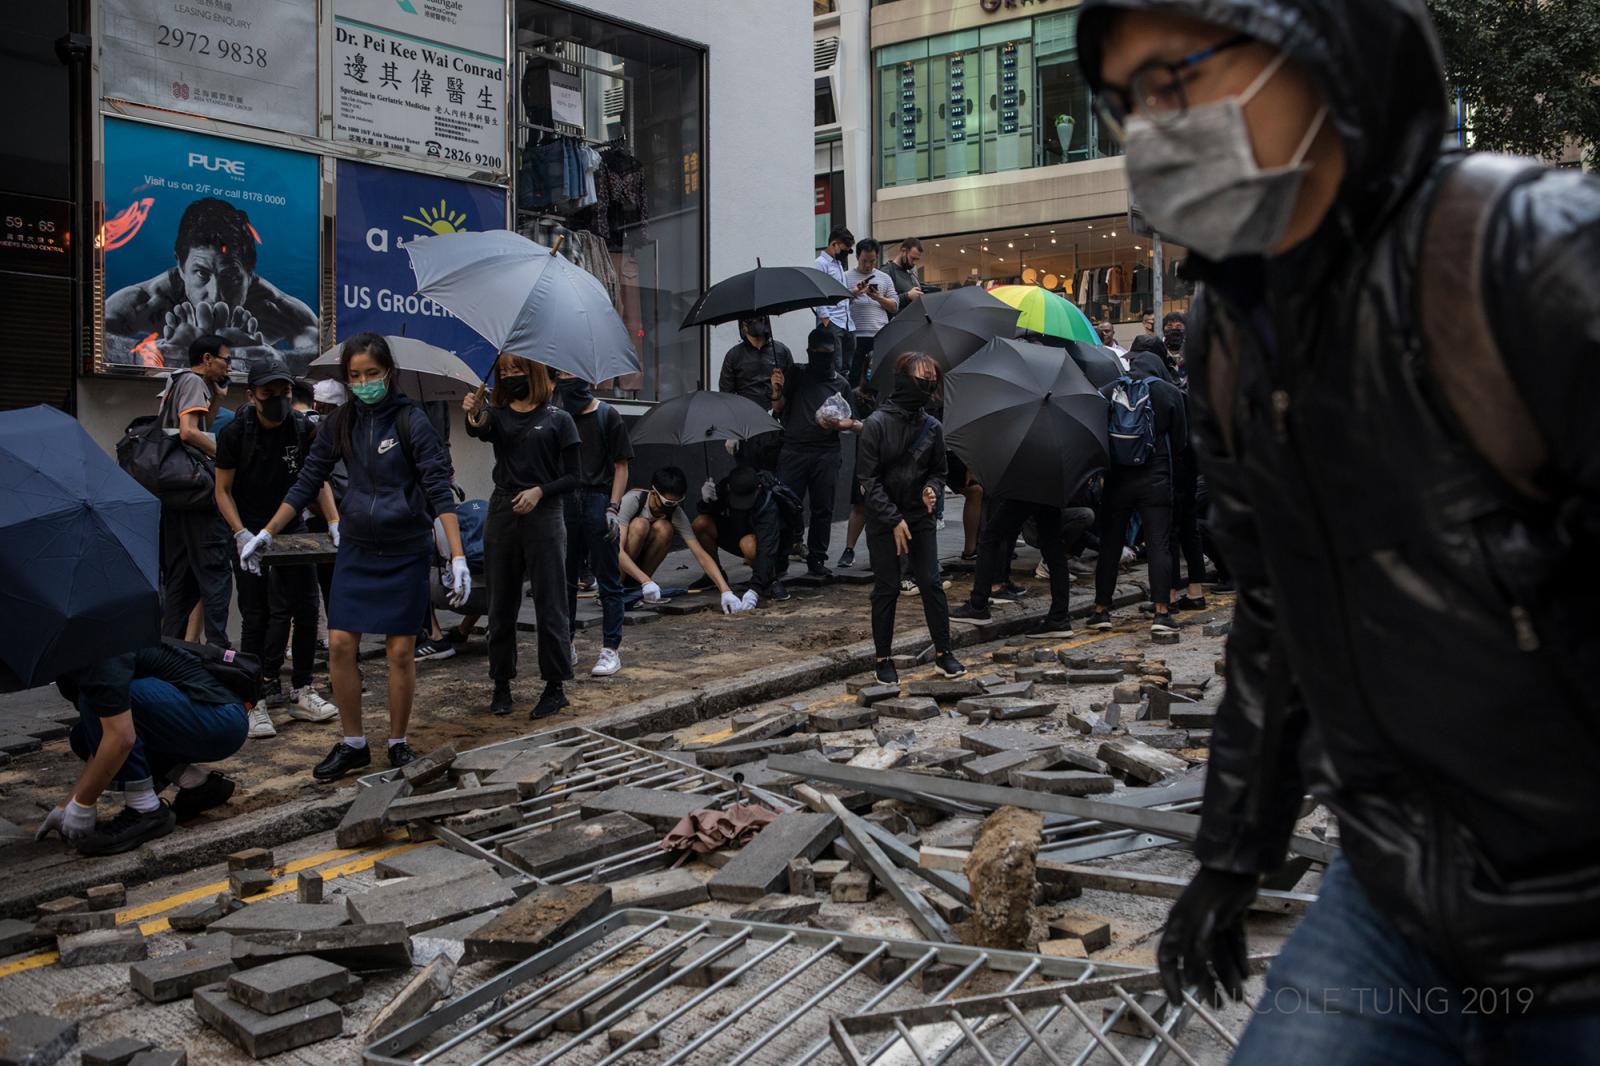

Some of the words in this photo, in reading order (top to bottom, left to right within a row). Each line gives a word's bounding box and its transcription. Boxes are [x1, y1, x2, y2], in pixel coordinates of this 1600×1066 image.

[174, 4, 211, 20] LEASING
[213, 13, 252, 30] ENQUIRY
[157, 25, 210, 55] 2972
[218, 39, 268, 68] 9838
[336, 27, 358, 46] Dr.
[363, 34, 385, 53] Pei
[390, 41, 417, 60] Kee
[422, 49, 448, 68] Wai
[453, 57, 502, 81] Conrad
[343, 52, 497, 111] 邊其偉醫生
[340, 86, 368, 98] Specialist
[369, 91, 376, 100] in
[377, 94, 403, 106] Geriatric
[405, 100, 431, 111] Medicine
[372, 131, 383, 139] Asia
[383, 133, 405, 142] Standard
[188, 152, 246, 176] PURE
[444, 147, 471, 163] 2826
[475, 153, 502, 169] 9200
[144, 174, 165, 187] Visit
[167, 180, 180, 189] us
[181, 182, 194, 191] on
[195, 183, 211, 193] 2/F
[212, 188, 224, 196] or
[225, 189, 241, 199] call
[242, 190, 263, 202] 8178
[264, 194, 286, 206] 0000
[6, 215, 23, 229] 59
[39, 220, 55, 233] 65
[366, 227, 388, 253] a
[344, 284, 371, 310] US
